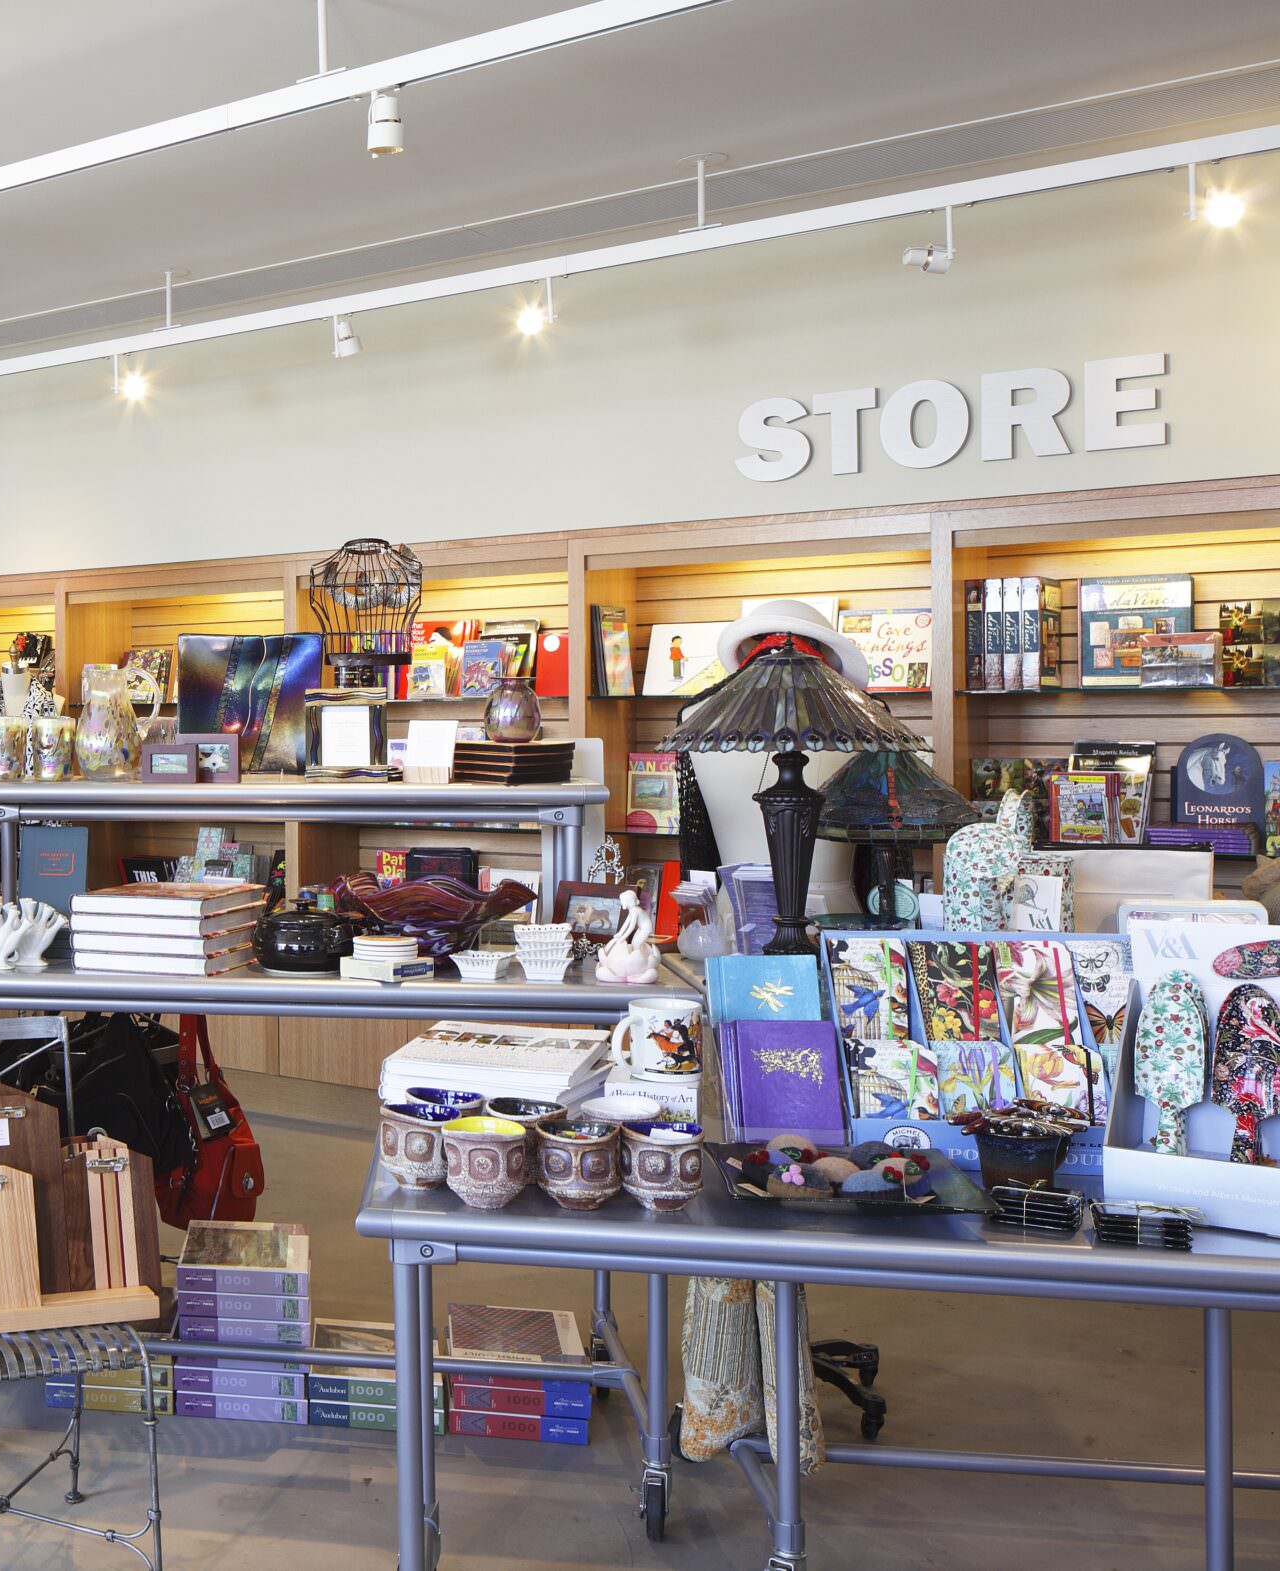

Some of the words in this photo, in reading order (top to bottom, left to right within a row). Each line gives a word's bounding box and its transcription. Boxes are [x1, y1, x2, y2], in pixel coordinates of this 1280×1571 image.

[734, 352, 1169, 483] STORE
[877, 621, 912, 639] Cave
[867, 657, 905, 682] ASSO
[629, 760, 656, 772] VAN
[1184, 801, 1252, 815] LEONARDO'S
[382, 851, 404, 865] Pat
[133, 870, 158, 882] THIS
[383, 865, 406, 878] Pla
[1142, 927, 1199, 960] V&A
[420, 1029, 604, 1050] GREAT
[638, 1091, 672, 1104] History
[678, 1094, 694, 1103] Art
[891, 1125, 922, 1138] MICHEL
[948, 1148, 978, 1161] PO
[219, 1275, 251, 1286] 1000
[220, 1300, 252, 1312] 1000
[221, 1325, 253, 1336] 1000
[215, 1376, 248, 1388] 1000
[319, 1385, 347, 1395] Audubon
[350, 1385, 384, 1397] 1000
[506, 1394, 541, 1407] 1000
[217, 1401, 251, 1414] 1000
[320, 1410, 348, 1420] Audubon
[352, 1411, 386, 1423] 1000
[502, 1420, 537, 1433] 1000
